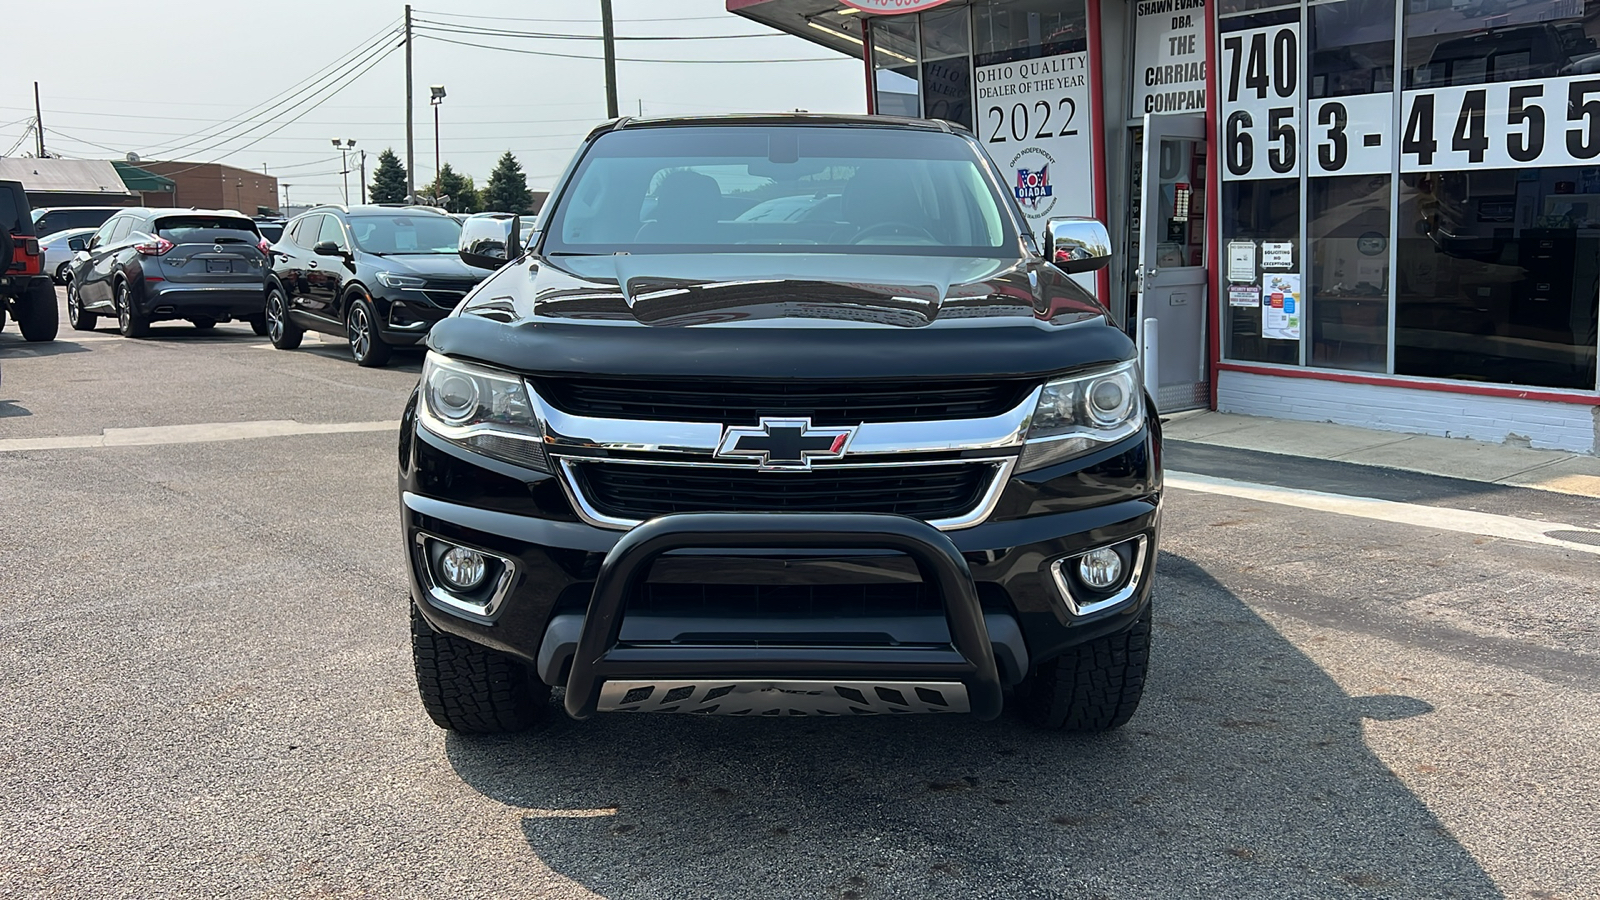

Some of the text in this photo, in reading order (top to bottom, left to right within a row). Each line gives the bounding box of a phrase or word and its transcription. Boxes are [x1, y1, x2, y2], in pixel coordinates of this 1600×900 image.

[1138, 0, 1172, 16] SHAWN
[1171, 15, 1194, 30] DBA.
[1168, 34, 1196, 56] THE
[977, 55, 1086, 83] OHIO QUALITY
[1224, 28, 1297, 103] 740
[979, 84, 1017, 99] DEALER
[1018, 82, 1032, 94] OF
[1033, 79, 1055, 92] THE
[1056, 74, 1085, 89] YEAR
[988, 97, 1078, 144] 2022
[1009, 147, 1056, 168] OHIO INDEPENDENT
[1018, 187, 1046, 198] OIADA
